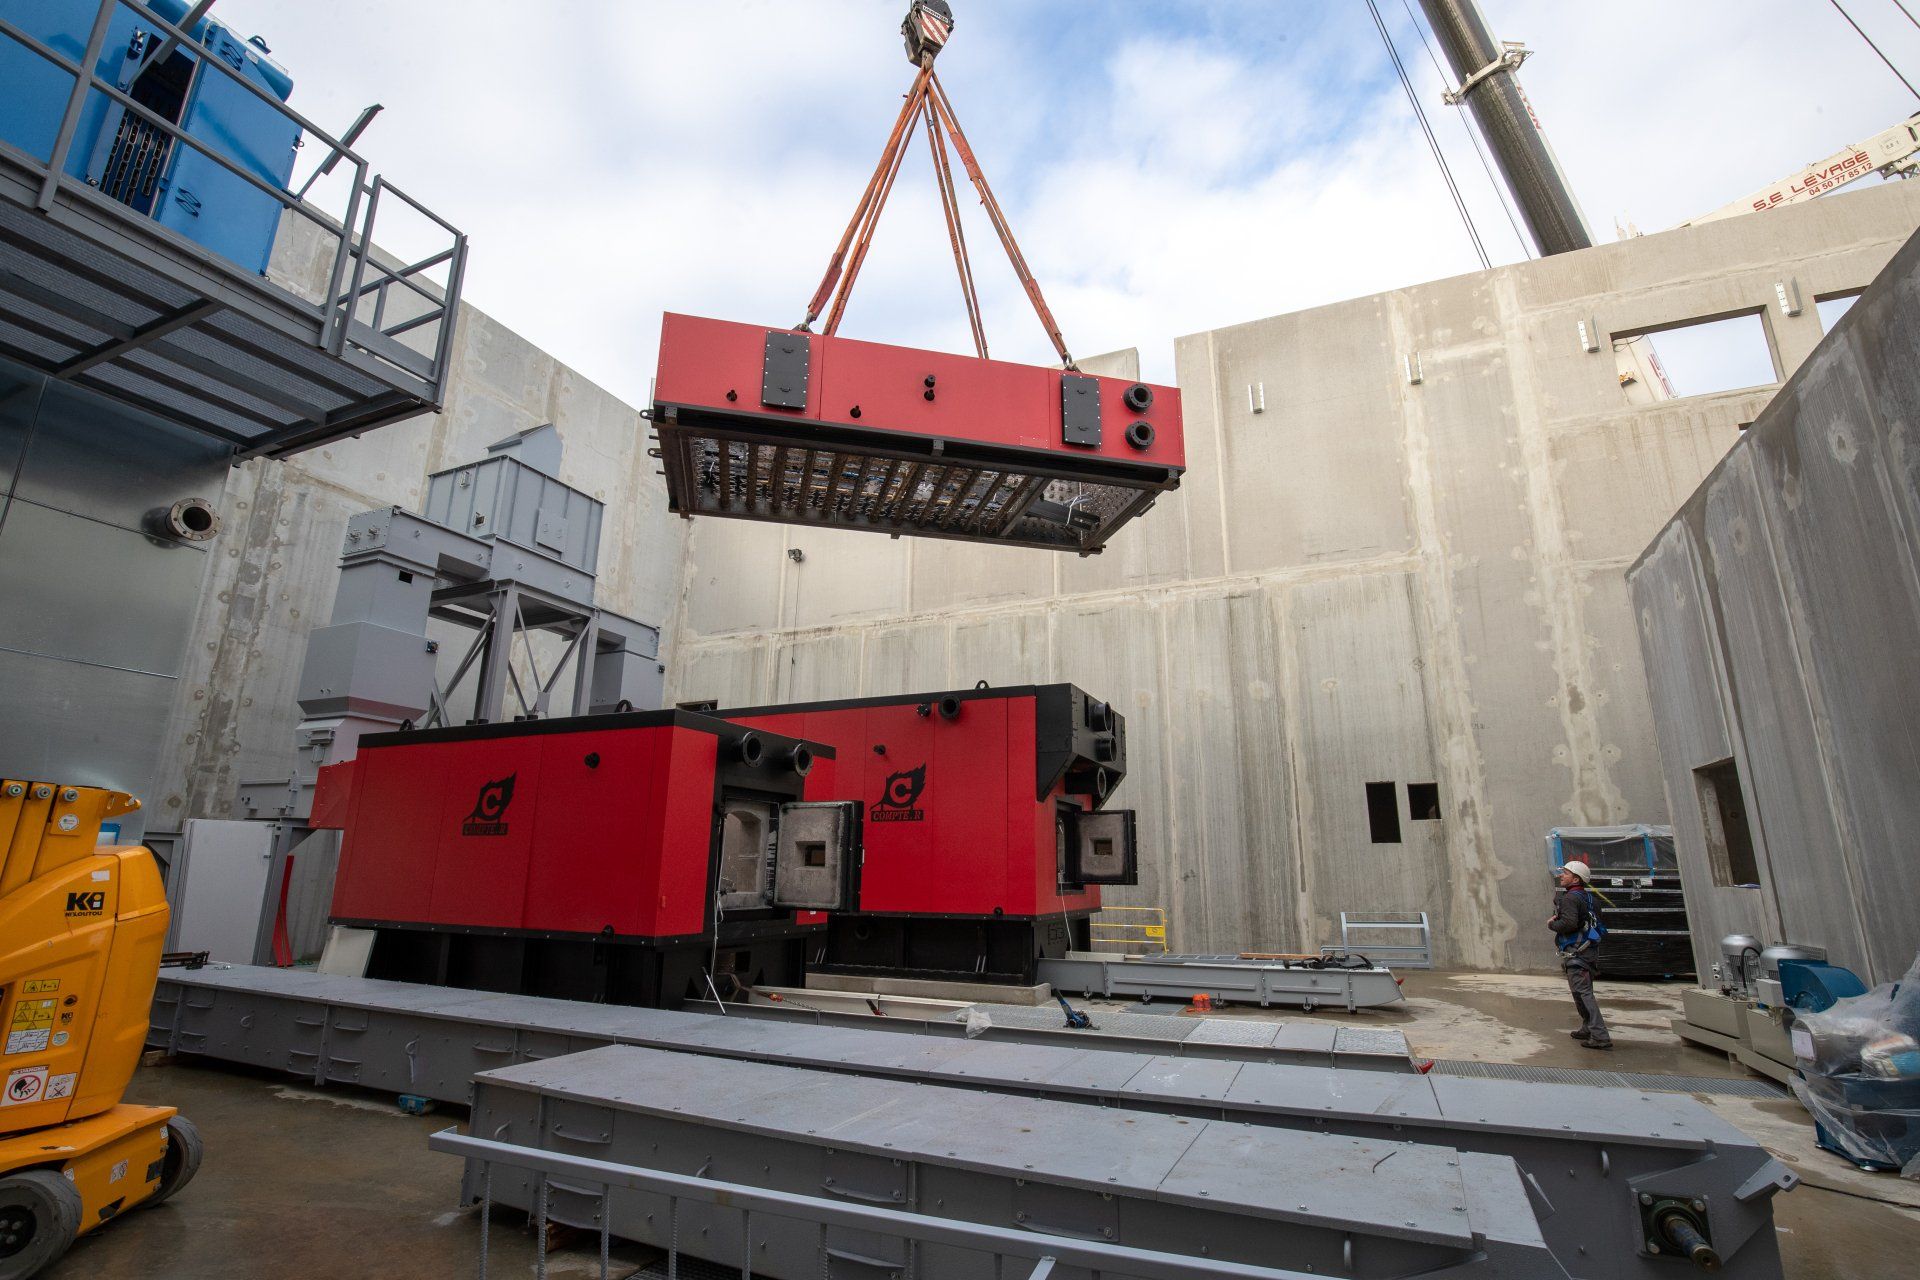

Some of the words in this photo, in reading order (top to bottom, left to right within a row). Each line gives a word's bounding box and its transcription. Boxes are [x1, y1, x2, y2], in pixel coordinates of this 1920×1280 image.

[1753, 191, 1783, 211] S.E
[1790, 151, 1869, 193] LEVAGE
[1809, 187, 1820, 196] 04
[1822, 181, 1834, 190] 50
[1835, 174, 1846, 184] 77
[1848, 168, 1860, 178] 85
[1862, 162, 1874, 172] 12
